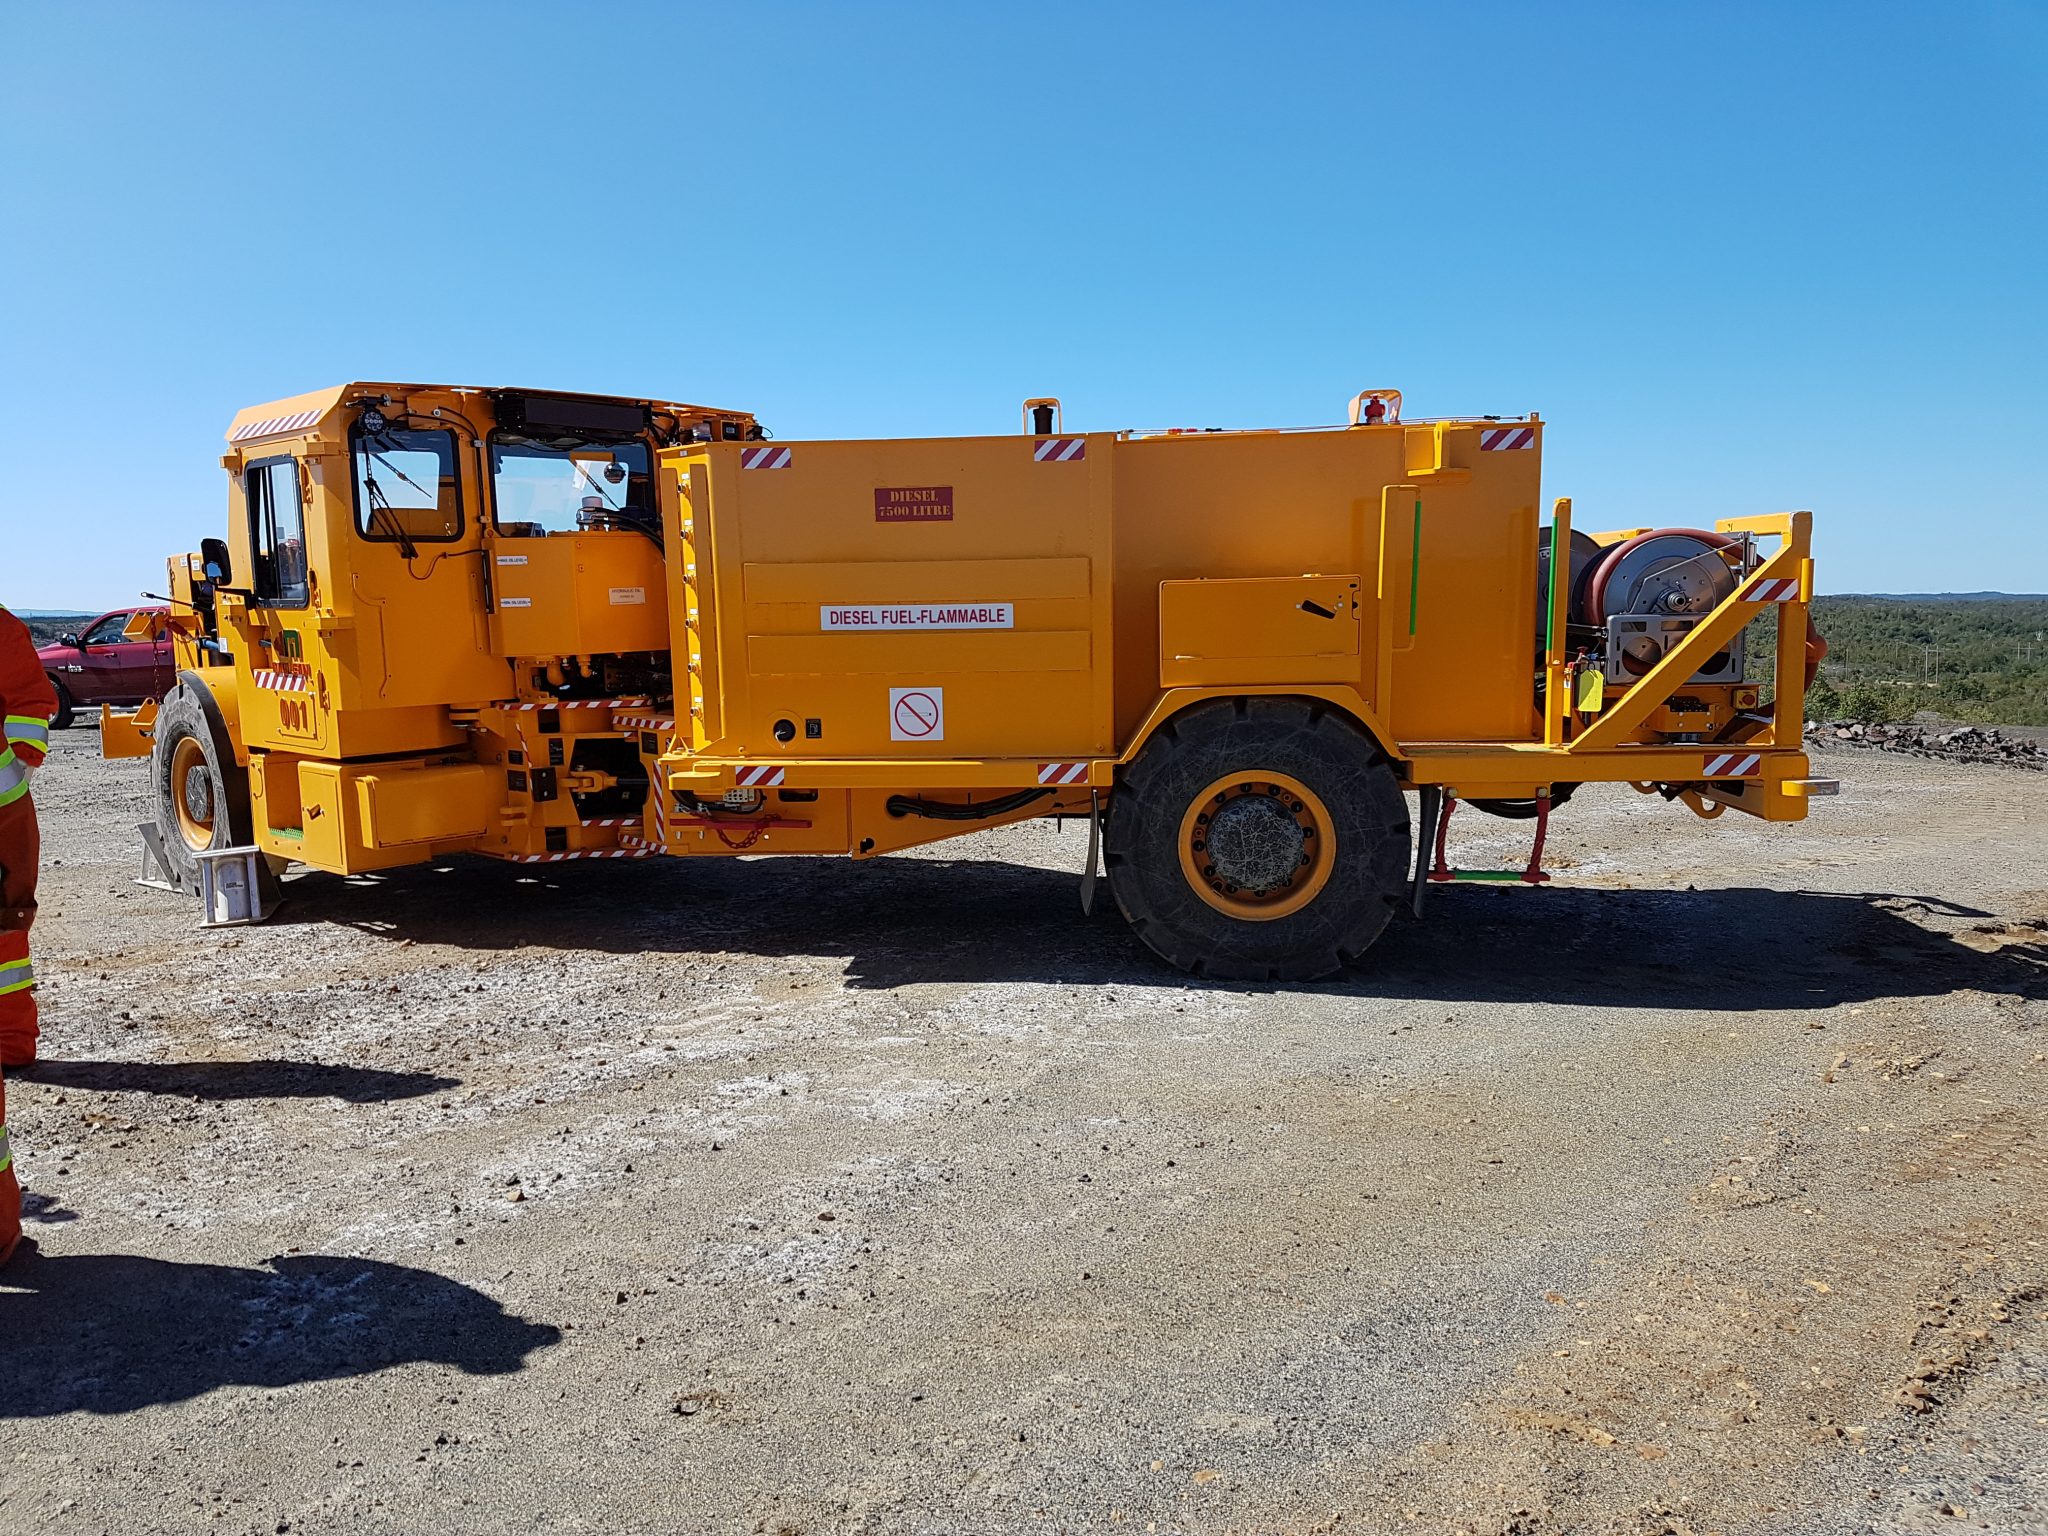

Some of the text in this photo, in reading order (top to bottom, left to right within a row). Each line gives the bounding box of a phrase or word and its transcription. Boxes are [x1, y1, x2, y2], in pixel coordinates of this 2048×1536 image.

[890, 490, 938, 502] DIESEL
[879, 505, 950, 517] 7500 LITRE
[830, 608, 1005, 625] DIESEL FUEL-FLAMMABLE
[280, 698, 308, 732] 001
